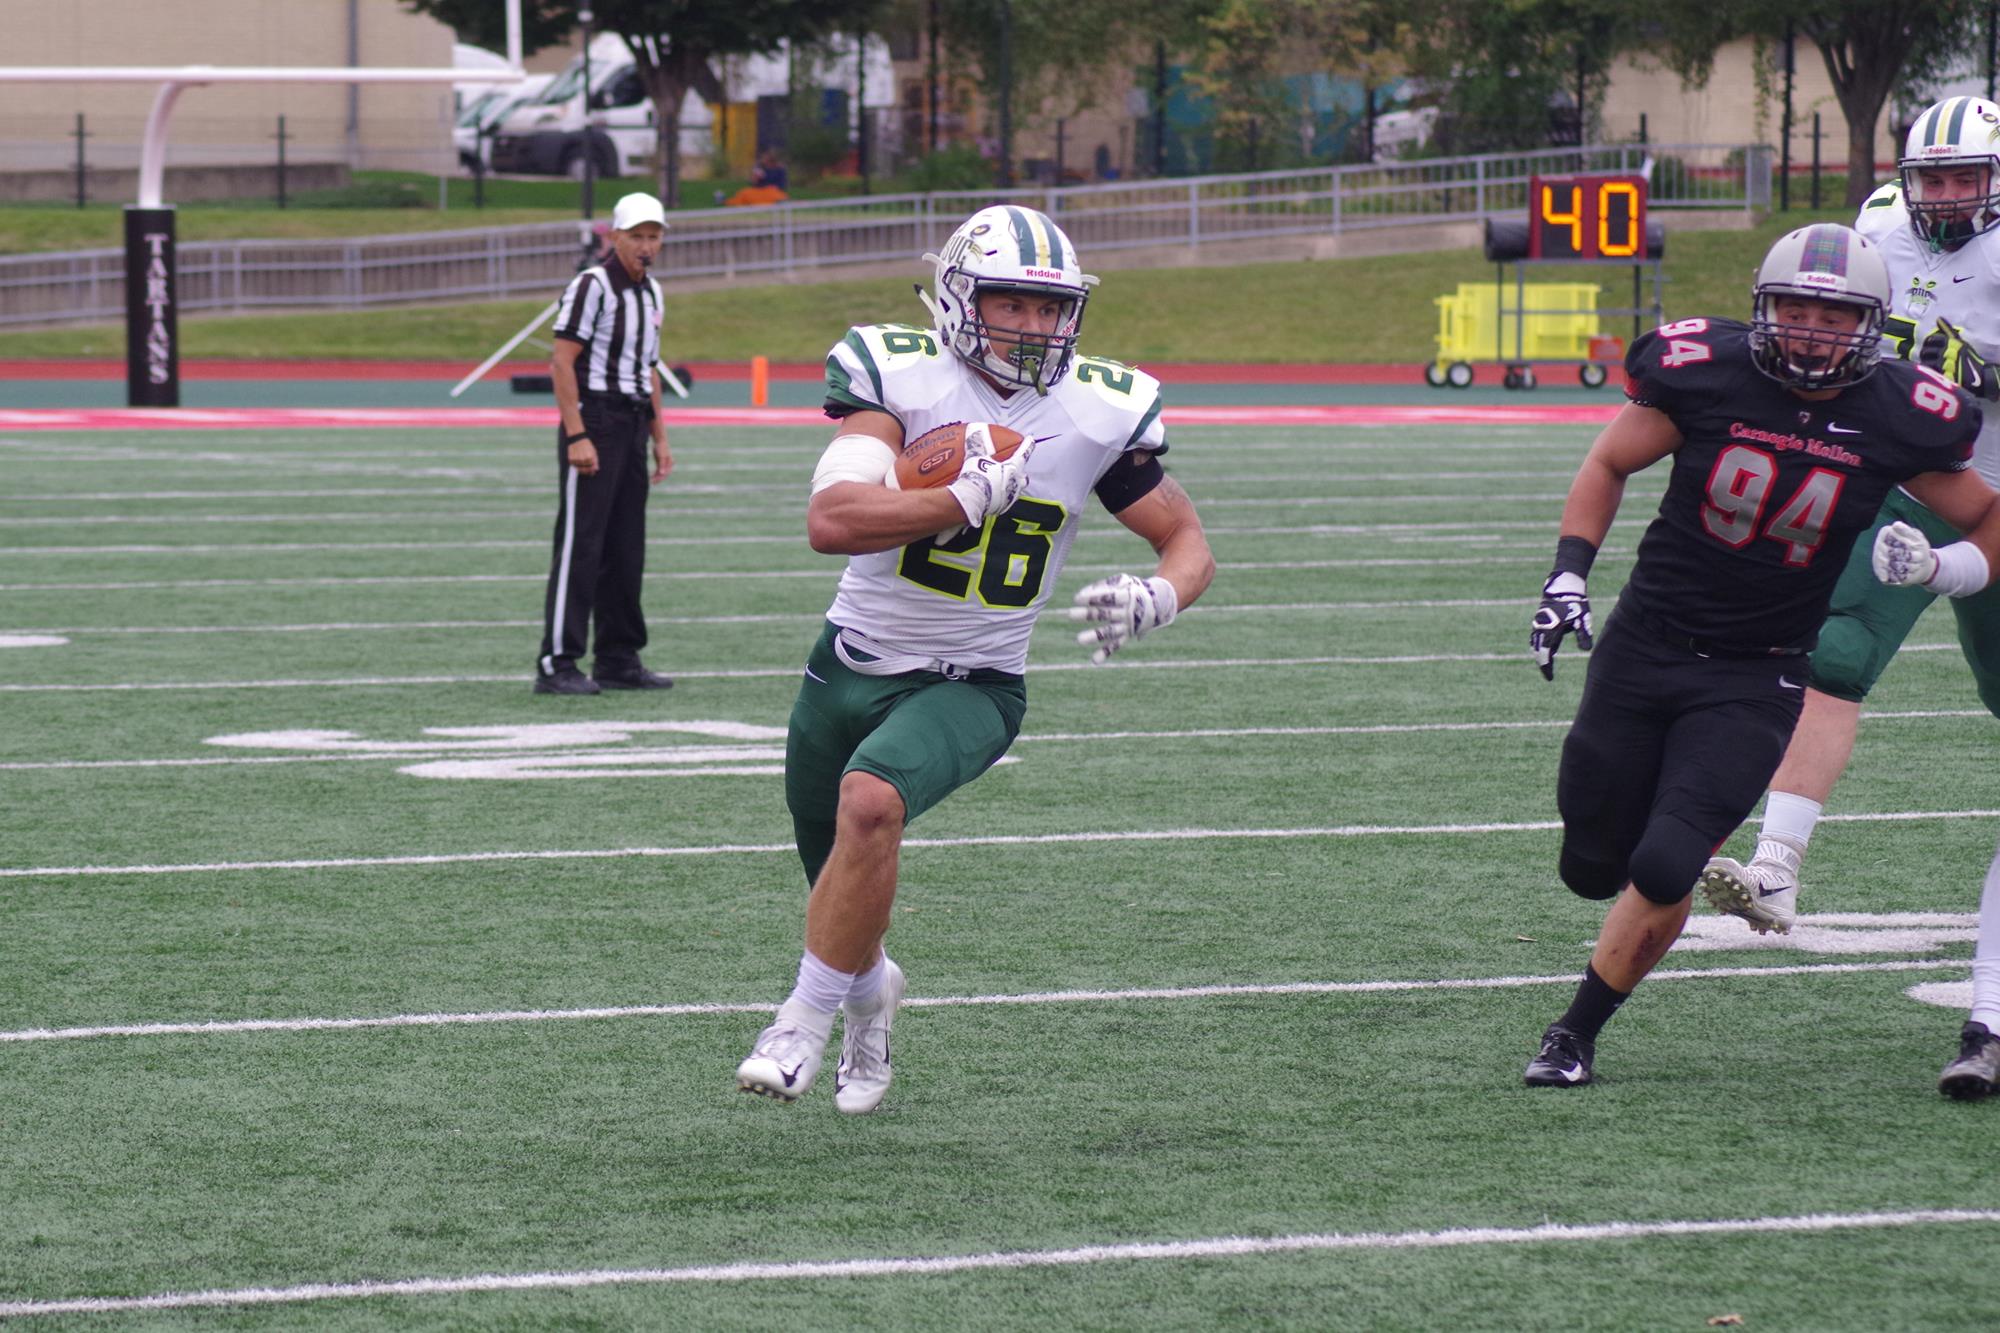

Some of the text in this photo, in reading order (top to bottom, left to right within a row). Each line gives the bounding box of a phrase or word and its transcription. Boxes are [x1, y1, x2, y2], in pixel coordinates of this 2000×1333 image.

[1542, 182, 1639, 256] 40
[1026, 268, 1062, 281] Riddell
[144, 232, 170, 384] TARTANS
[1656, 317, 1713, 369] 94
[919, 447, 954, 472] GST
[1729, 422, 1861, 467] Carnegie Mellon
[1699, 444, 1848, 567] 94
[896, 495, 1068, 609] 26
